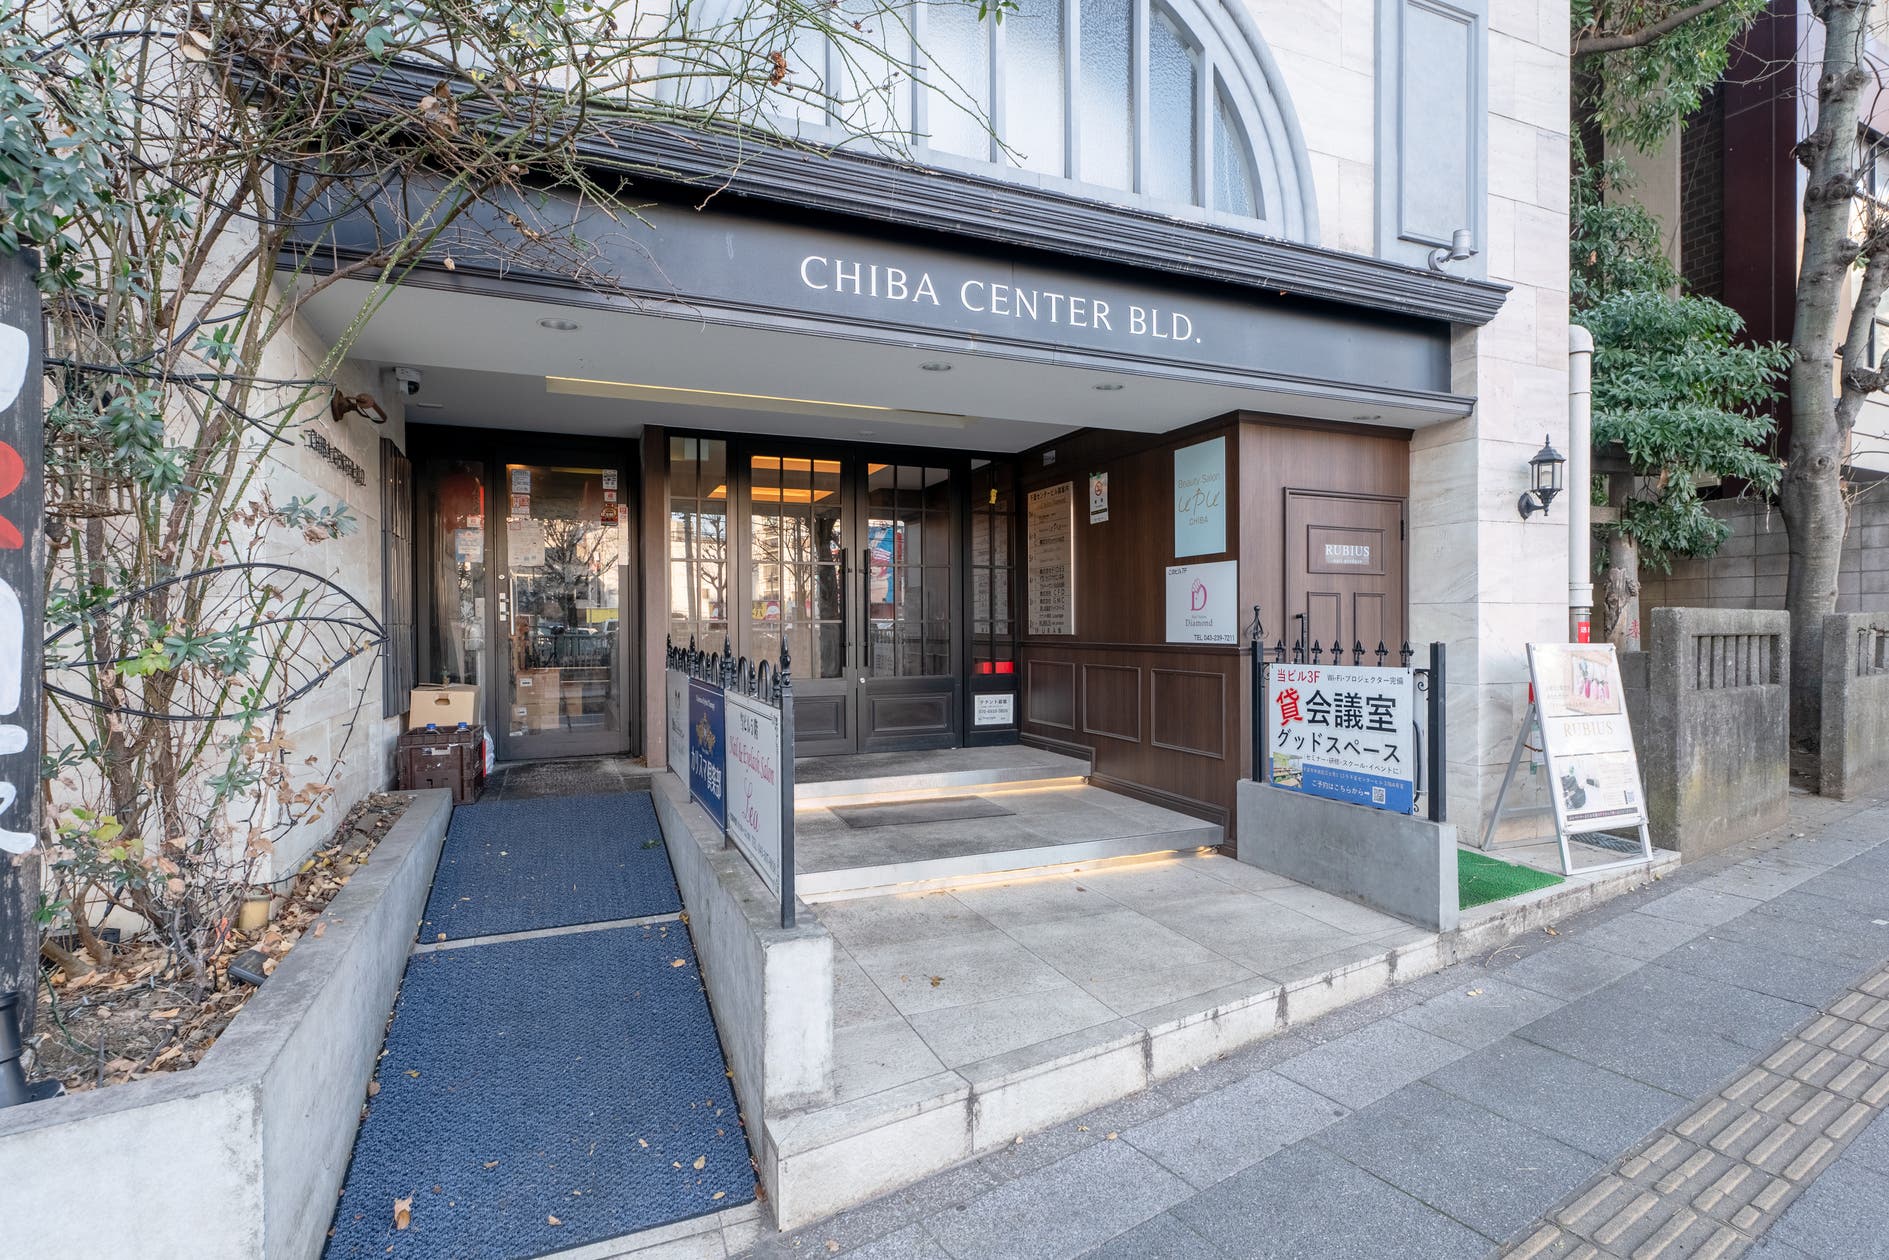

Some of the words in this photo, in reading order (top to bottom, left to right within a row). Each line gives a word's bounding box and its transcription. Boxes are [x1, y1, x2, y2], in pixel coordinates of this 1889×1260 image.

[801, 256, 940, 305] CHIBA
[961, 280, 1112, 331] CENTER
[1129, 306, 1201, 344] BLD.
[1189, 516, 1209, 526] CHIBA
[1325, 544, 1370, 557] RUBIUS
[1185, 619, 1213, 627] Diamond
[1277, 669, 1321, 684] 当ビル3F
[1563, 720, 1615, 737] RUBIUS
[1277, 728, 1400, 763] グッドスペース
[1311, 779, 1364, 796] ご予約はこちらから
